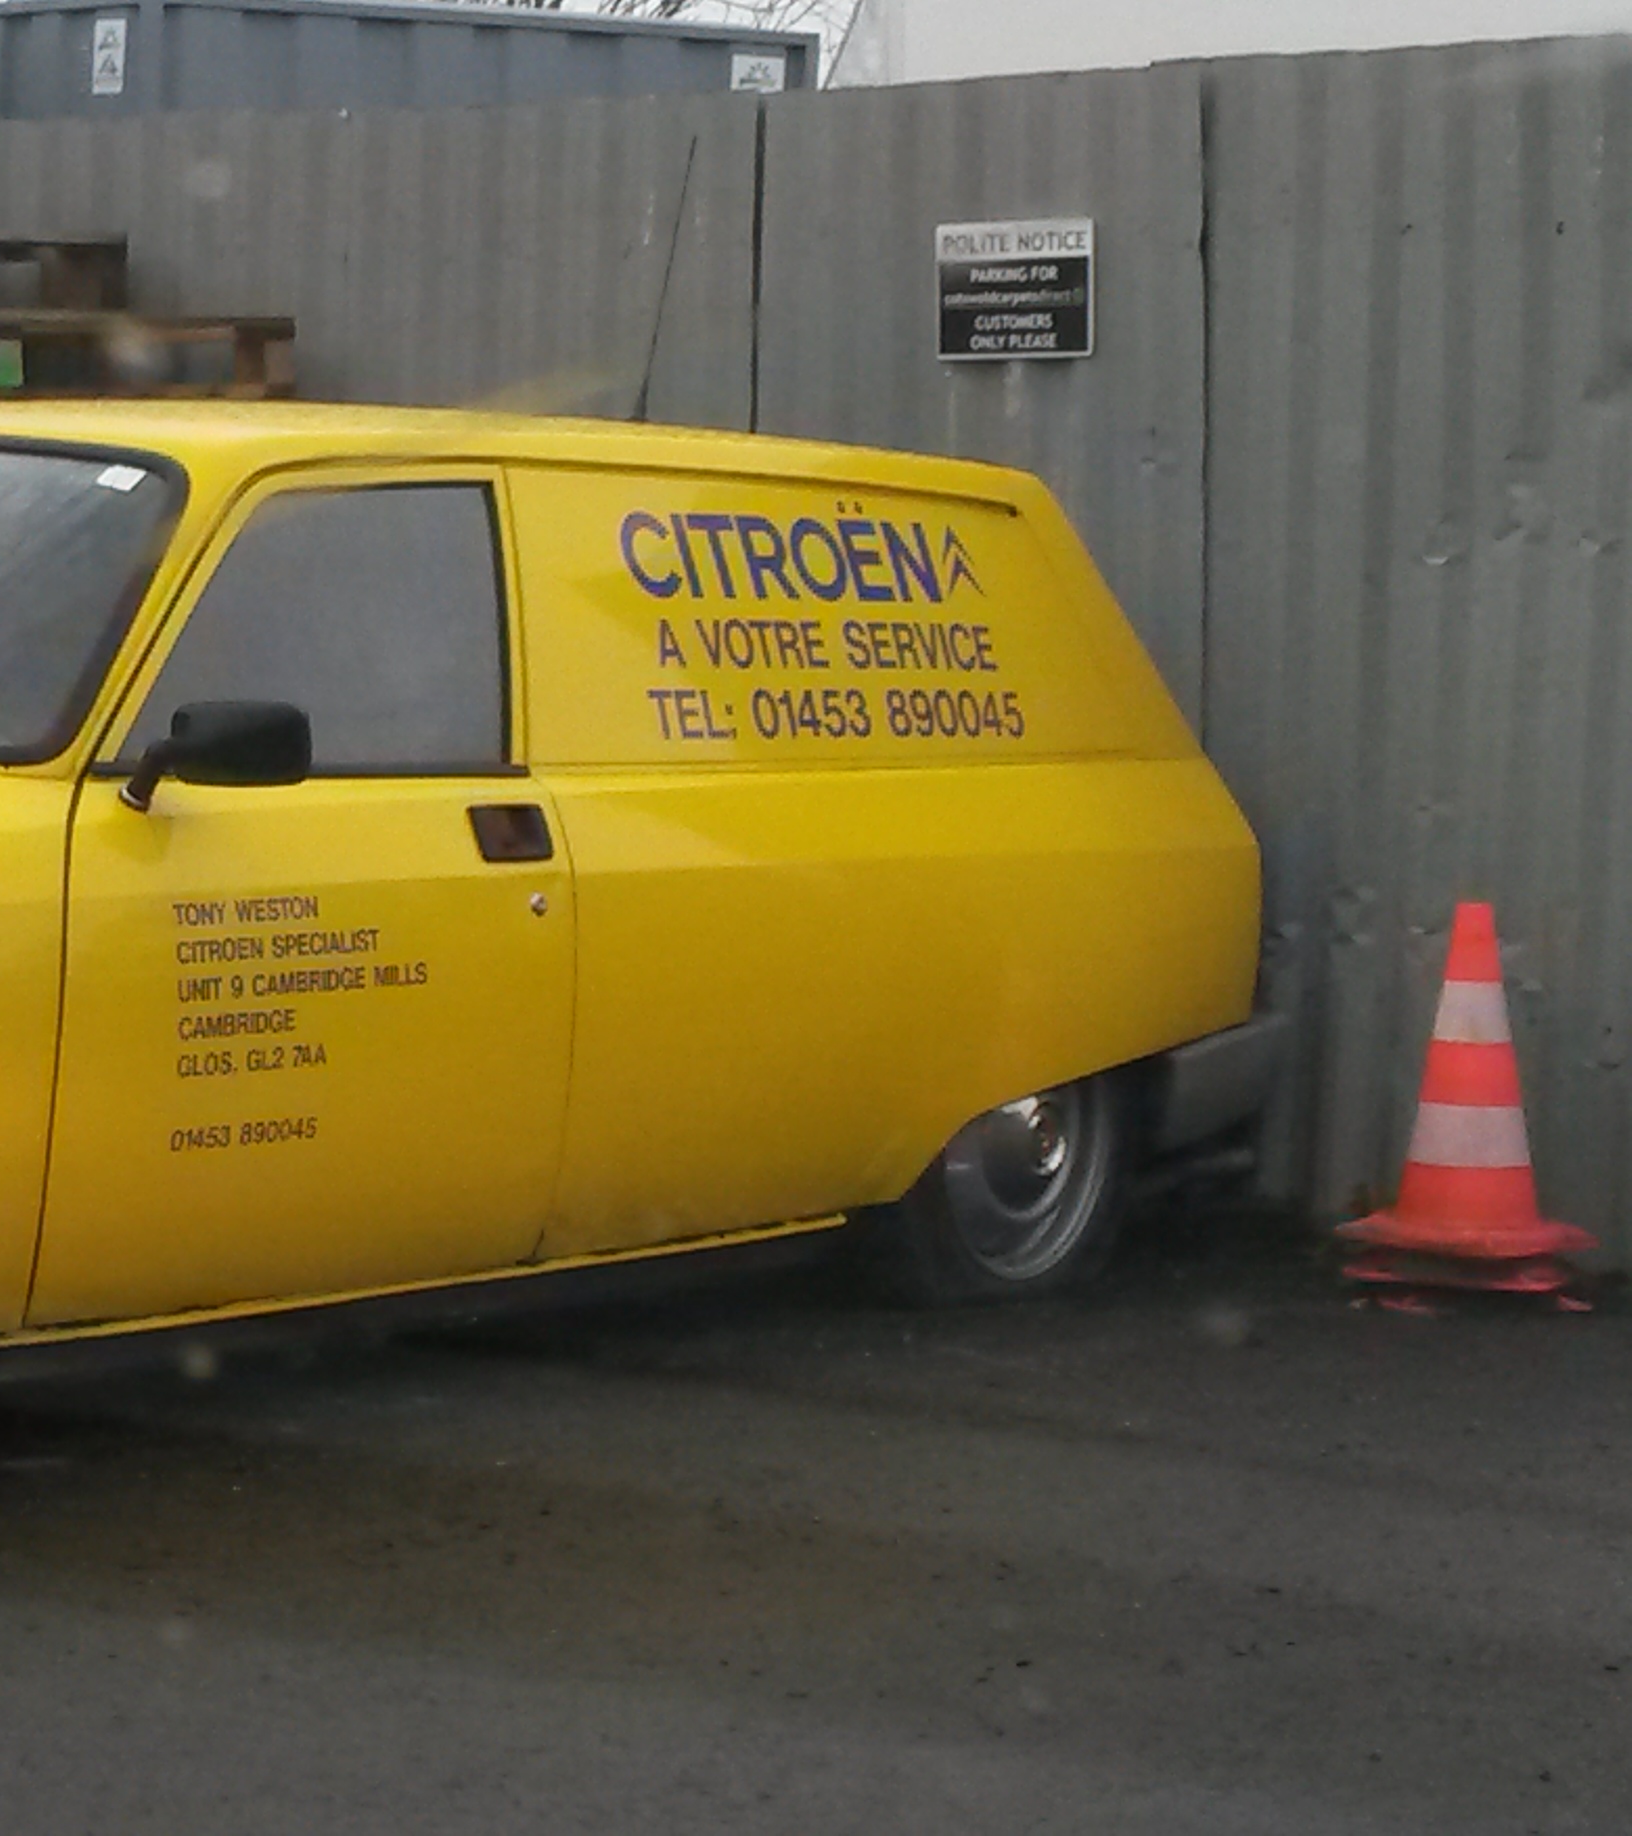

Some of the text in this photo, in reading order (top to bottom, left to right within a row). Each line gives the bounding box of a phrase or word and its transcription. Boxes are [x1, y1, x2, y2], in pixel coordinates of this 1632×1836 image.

[1019, 230, 1087, 250] NOTICE
[970, 265, 1059, 283] PARKING FOR
[974, 313, 1053, 331] CUSTOMERS
[970, 332, 1057, 350] ONLY PLEASE
[620, 501, 943, 602] CITROËN
[696, 619, 829, 669] VOTRE
[843, 621, 997, 672] SERVICE
[647, 689, 1025, 740] TEL: 01453 890045
[173, 896, 319, 926] TONY WESTON
[176, 929, 380, 964] CITROEN SPECIALIST
[177, 962, 427, 1002] UNIT 9 CAMBRIDGE MILLS
[177, 1009, 296, 1040] CAMBRIDGE
[177, 1044, 327, 1078] GLOS. GL2 7AA
[170, 1117, 318, 1152] 01453 890045
